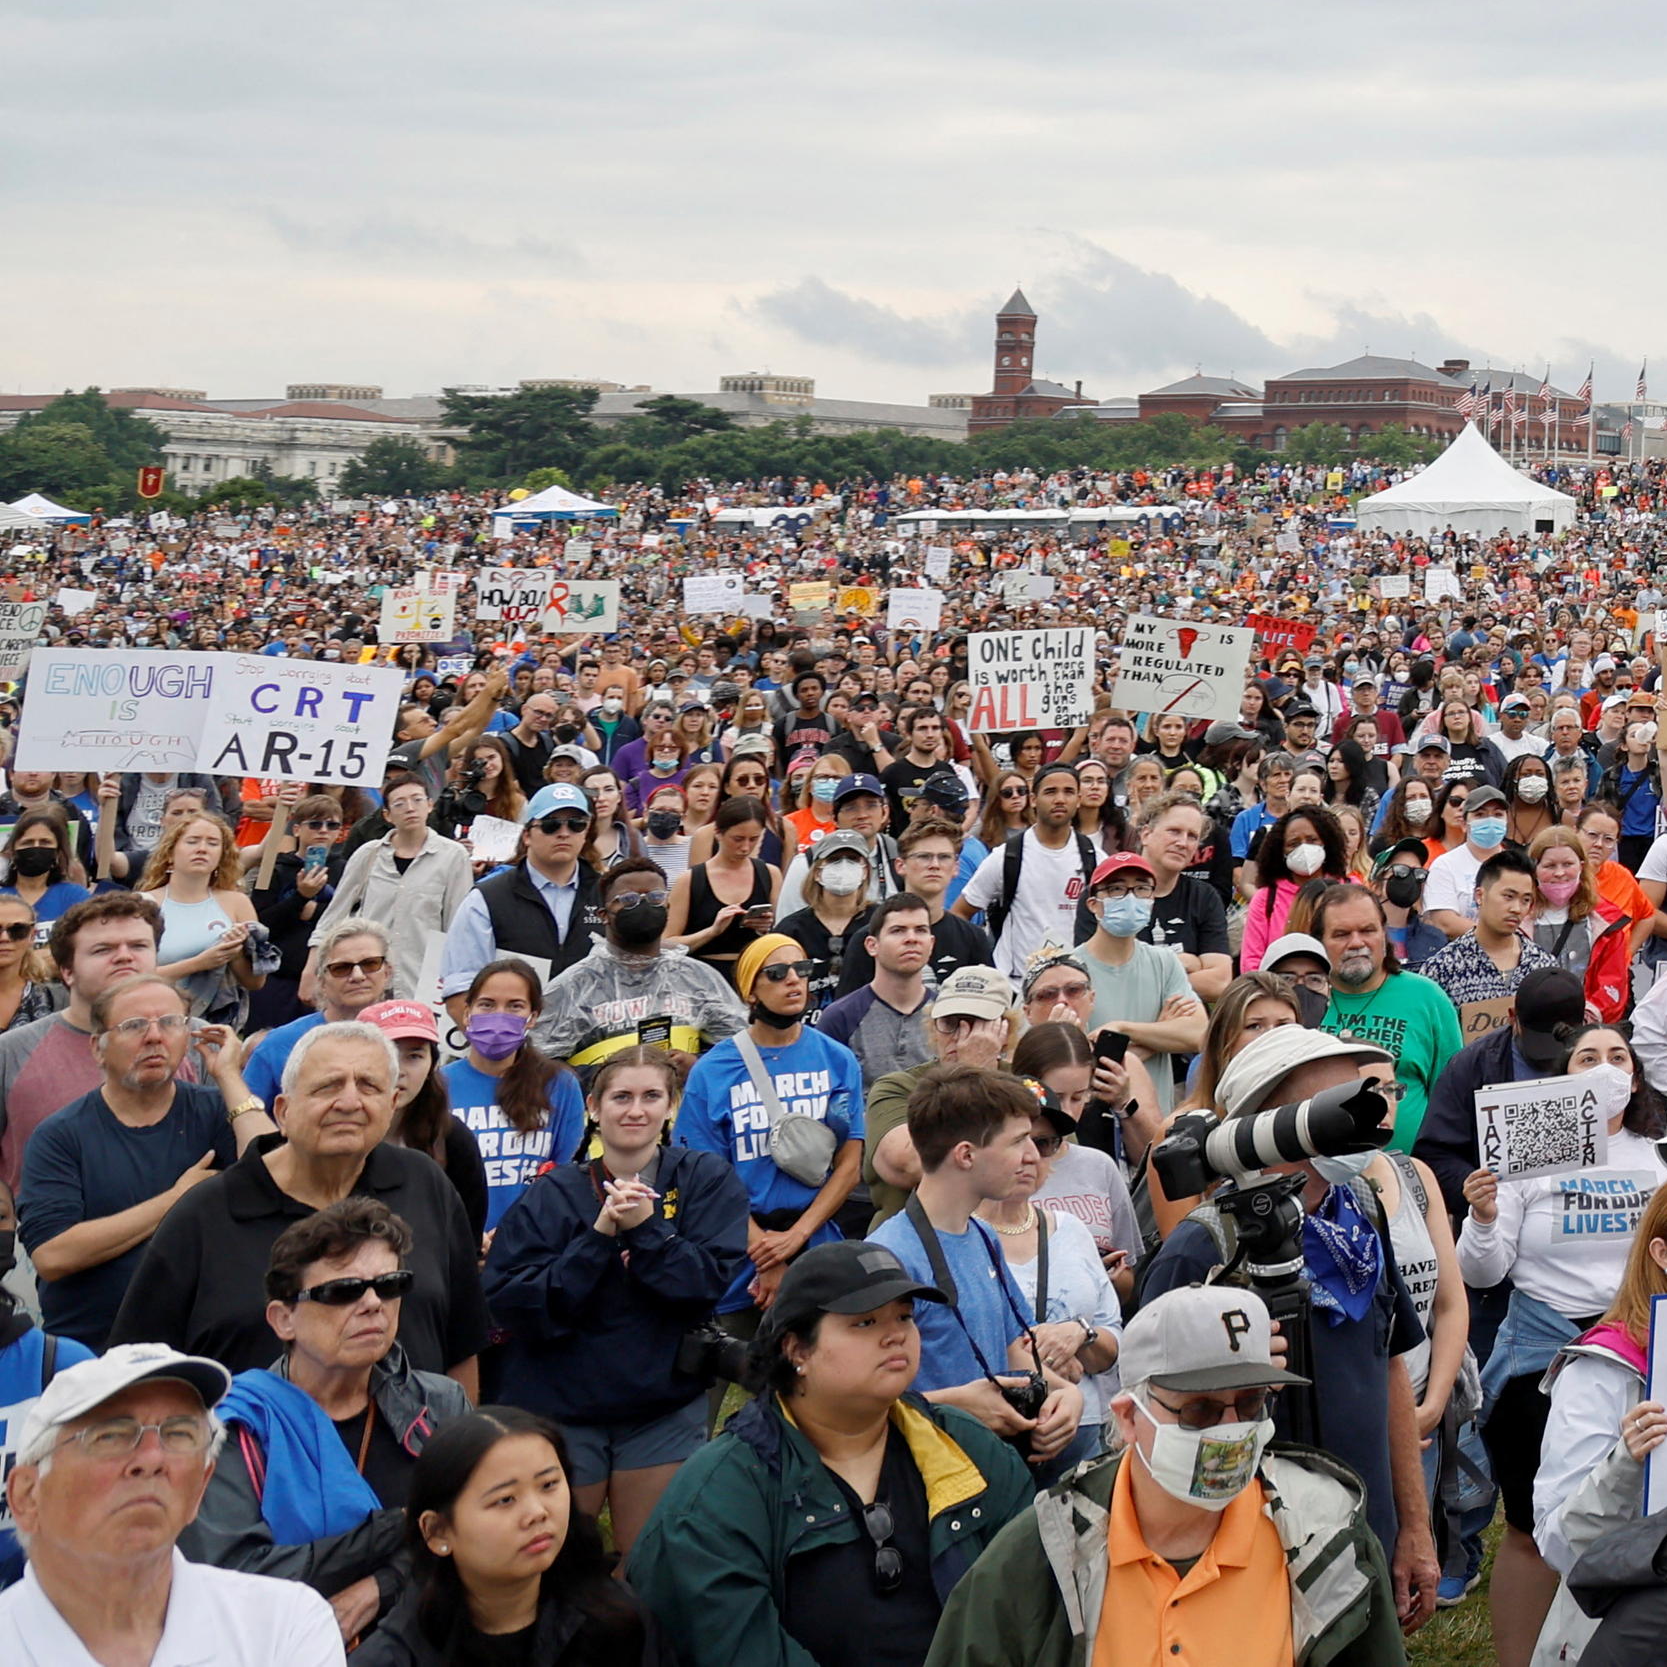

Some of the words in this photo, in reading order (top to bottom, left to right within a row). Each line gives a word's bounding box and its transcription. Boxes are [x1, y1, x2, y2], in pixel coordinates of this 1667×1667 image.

[480, 589, 515, 606] HOW
[1134, 623, 1157, 634] MY
[981, 635, 1022, 663] ONE
[1032, 631, 1084, 659] Child
[1124, 638, 1165, 653] MORE
[1262, 631, 1295, 646] LIFE
[235, 656, 265, 676] Stop
[279, 667, 332, 685] worrying
[975, 670, 989, 685] is
[995, 662, 1047, 684] worth
[1054, 661, 1084, 670] more
[1055, 670, 1084, 680] than
[1133, 656, 1224, 677] REGULATED
[44, 663, 213, 699] ENOUGH
[1122, 669, 1163, 683] THAN
[1044, 682, 1074, 695] the
[109, 700, 139, 721] IS
[251, 684, 375, 723] CRT
[969, 683, 1037, 730] ALL
[1042, 694, 1077, 713] guns
[1056, 706, 1068, 714] on
[212, 731, 368, 779] AR-15
[1371, 1015, 1408, 1032] THE
[1580, 1089, 1598, 1167] ACTION
[1560, 1178, 1636, 1194] MARCH
[1563, 1192, 1608, 1210] FOR
[1562, 1212, 1628, 1234] LIVES
[1220, 1308, 1251, 1352] P
